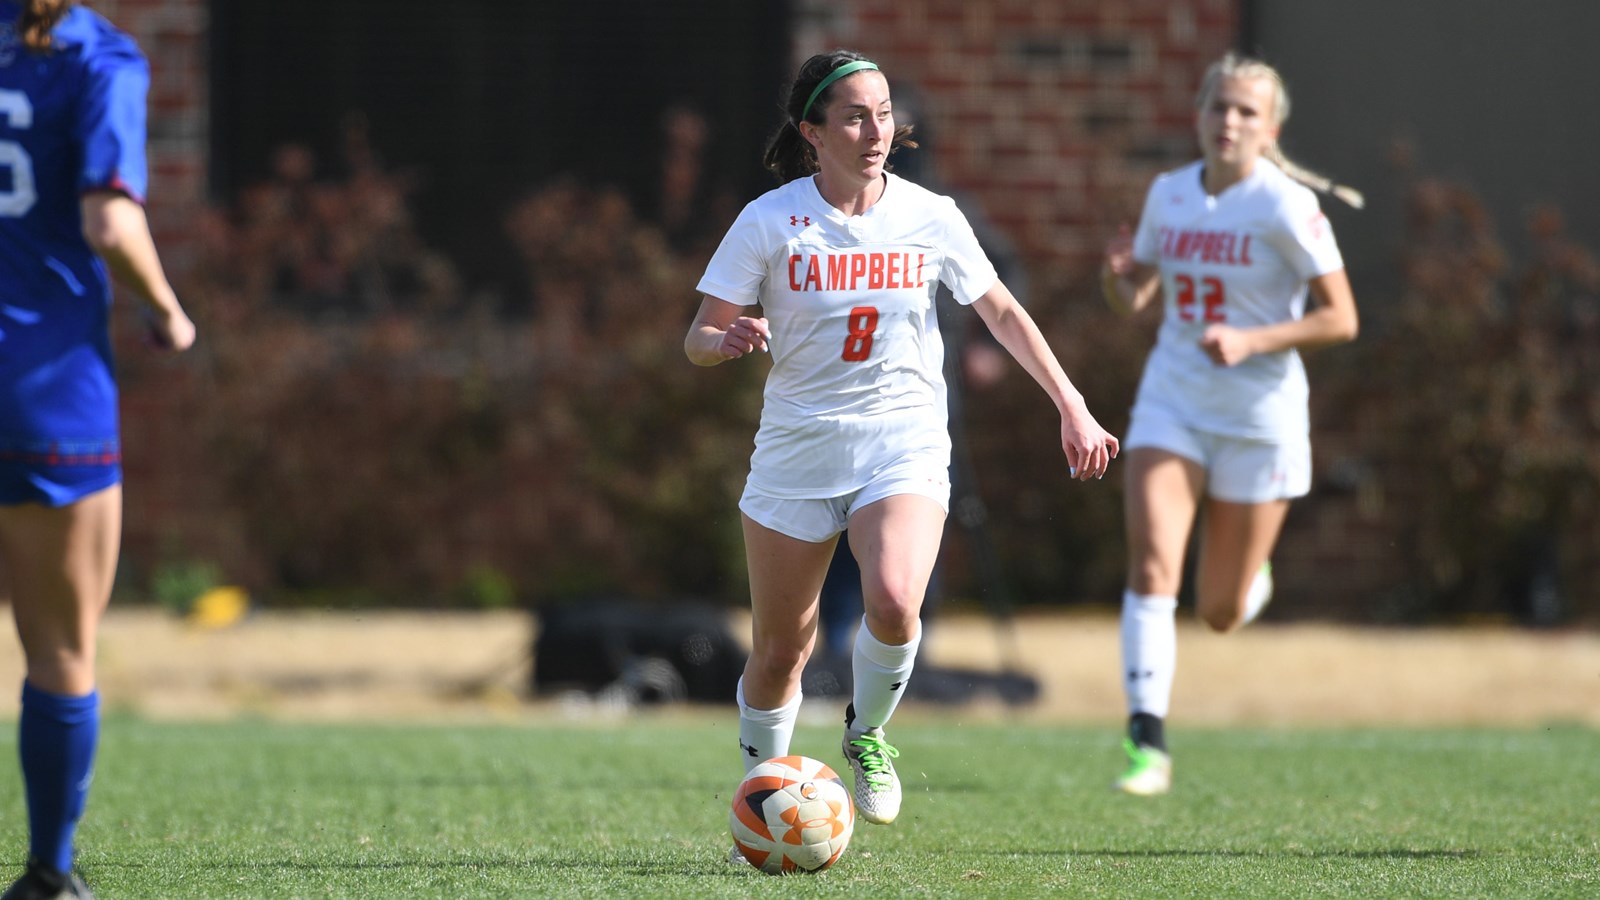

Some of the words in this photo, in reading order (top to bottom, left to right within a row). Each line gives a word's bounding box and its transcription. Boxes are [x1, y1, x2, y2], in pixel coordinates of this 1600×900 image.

[1157, 227, 1254, 266] CAMPBELL
[788, 253, 925, 291] CAMPBELL
[1174, 274, 1227, 322] 22
[841, 306, 879, 362] 8
